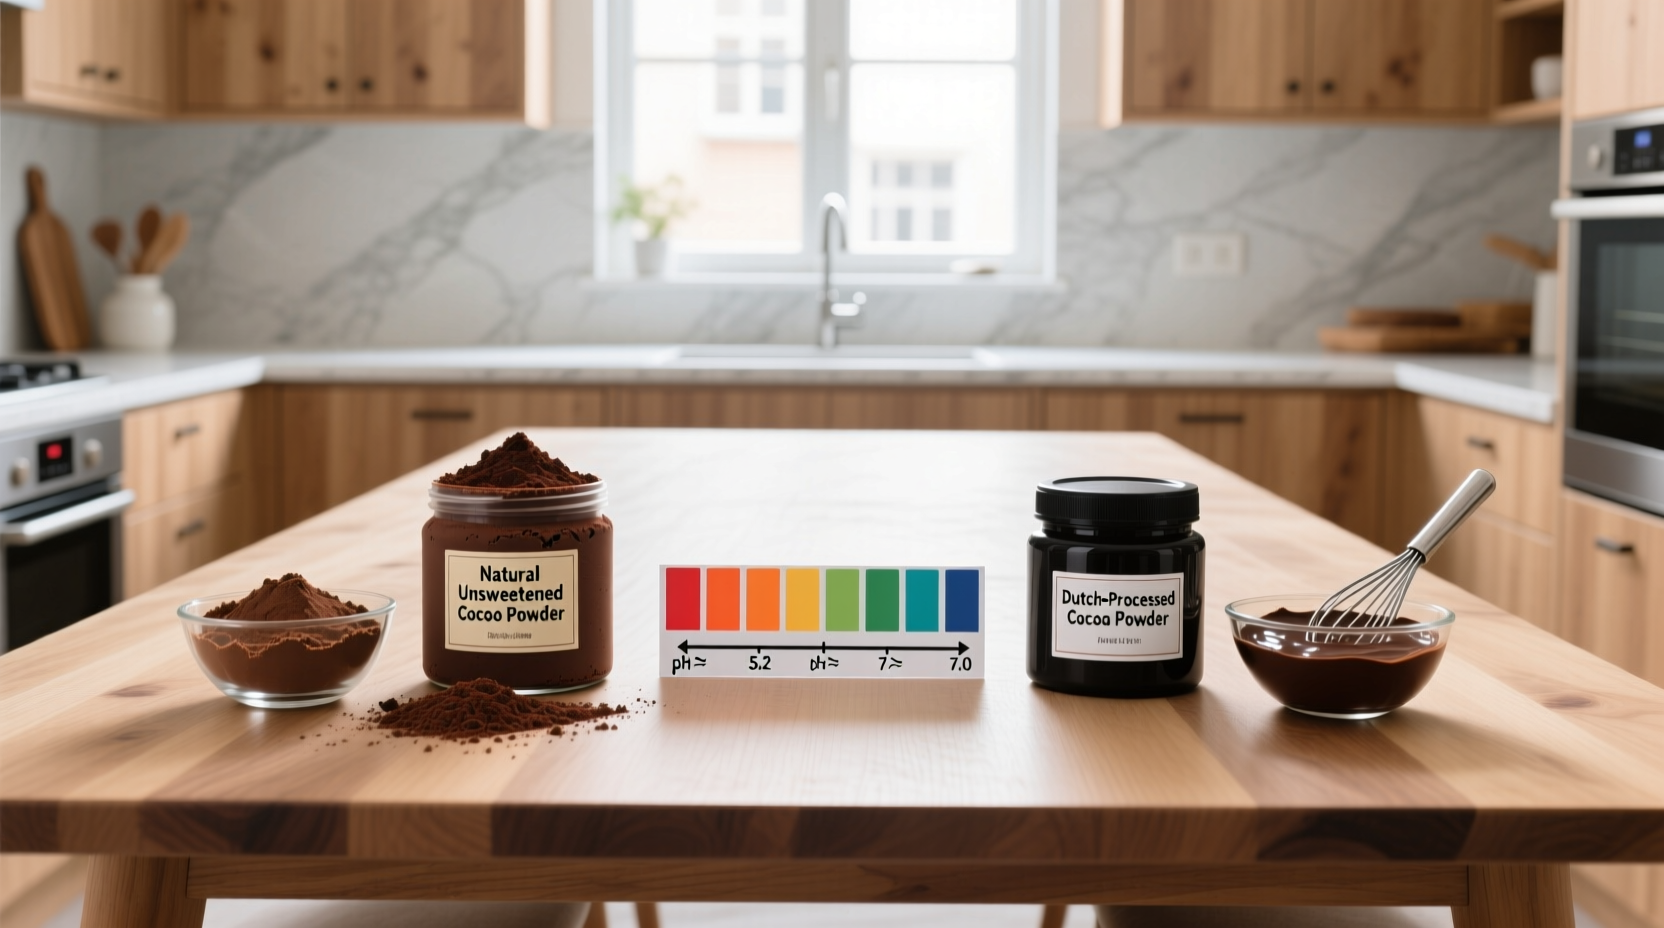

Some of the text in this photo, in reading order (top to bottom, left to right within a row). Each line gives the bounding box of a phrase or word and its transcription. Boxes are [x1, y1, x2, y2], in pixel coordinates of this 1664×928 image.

[480, 564, 540, 582] Natural
[458, 583, 564, 602] Unsweetened
[1062, 589, 1176, 607] Dutch-Processed
[506, 604, 566, 622] Powder
[1067, 609, 1170, 627] Cocoa Powder
[748, 655, 772, 671] 5.2
[949, 656, 973, 671] 7.0
